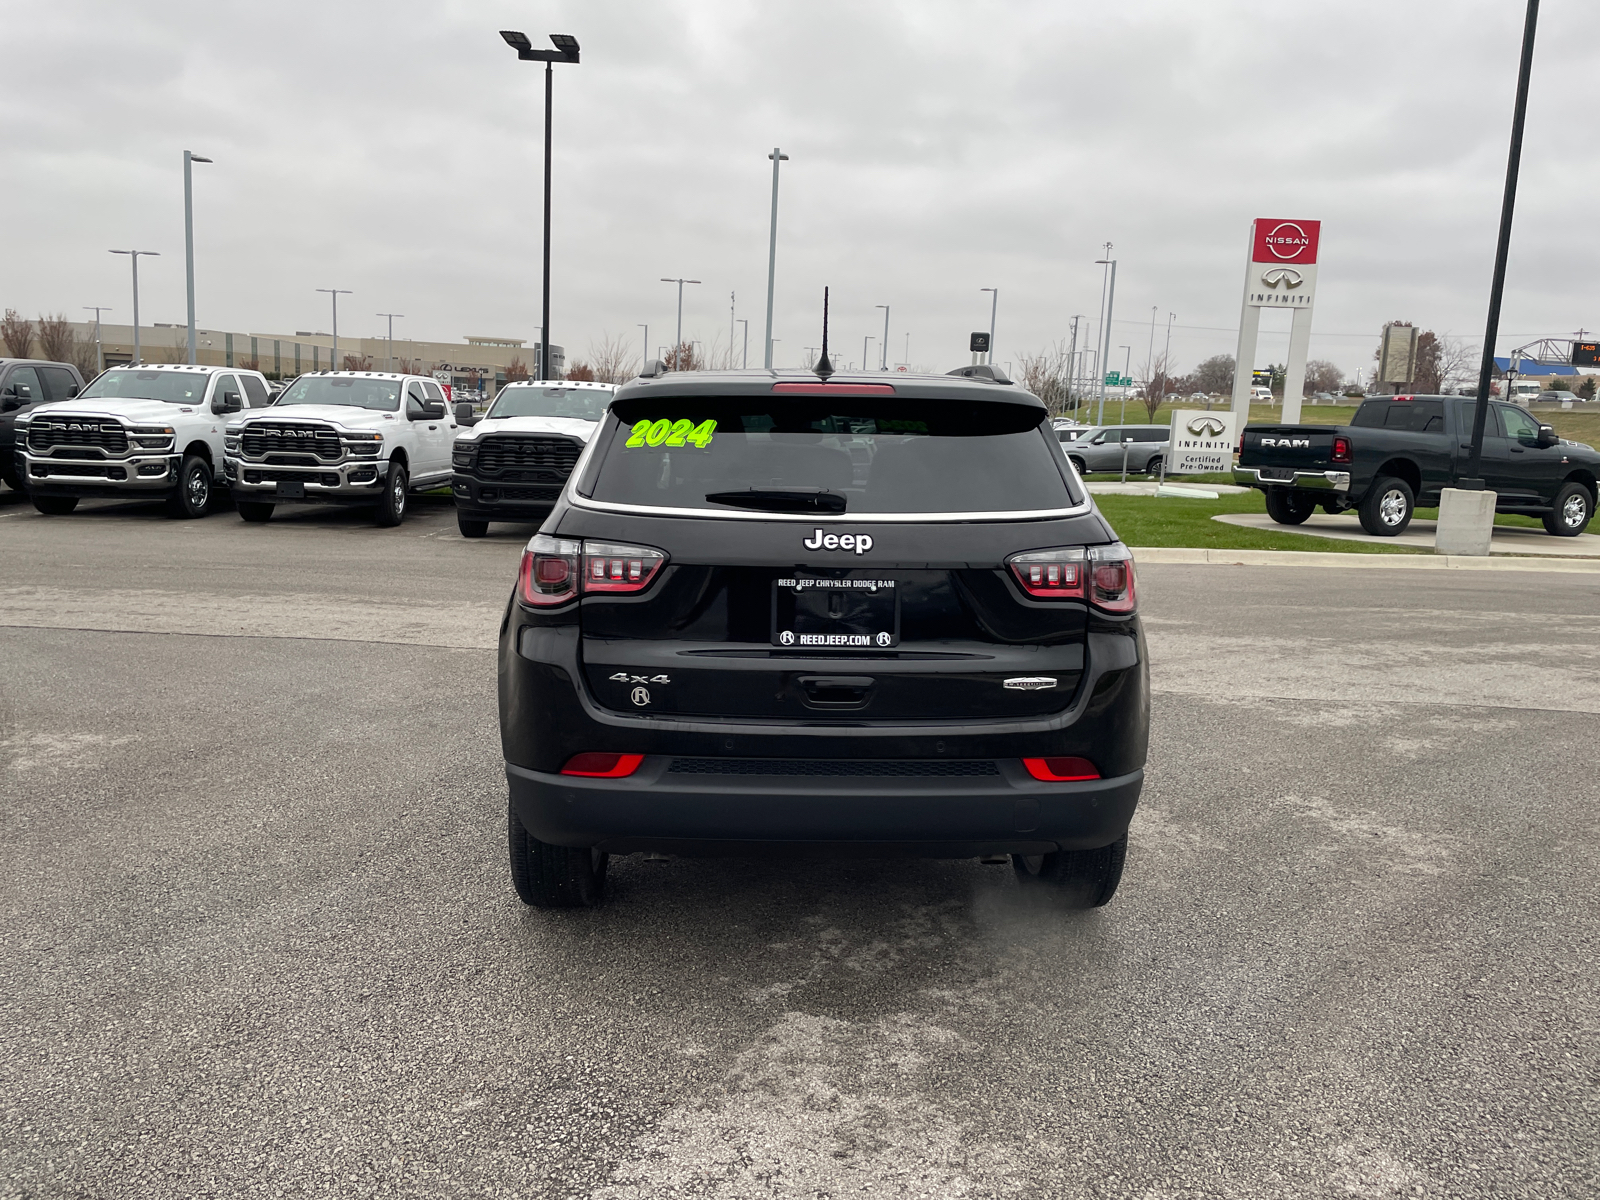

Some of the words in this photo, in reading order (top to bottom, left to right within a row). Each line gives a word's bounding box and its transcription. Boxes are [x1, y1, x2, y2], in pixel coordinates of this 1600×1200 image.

[1265, 236, 1309, 245] NISSAN
[1250, 293, 1311, 304] INFINITI
[454, 366, 489, 374] LEXUS
[50, 422, 99, 432] RAM
[265, 428, 314, 438] RAM
[625, 418, 718, 449] 2024
[503, 443, 555, 453] RAM
[1178, 440, 1230, 449] INFINITI
[1260, 438, 1310, 449] RAM
[1185, 455, 1221, 463] Certified
[1180, 463, 1224, 471] Pre-Owned
[803, 528, 875, 556] Jeep
[778, 579, 796, 587] REED
[798, 579, 815, 588] JEEP
[816, 579, 851, 588] CHRYSLER
[853, 580, 876, 588] DODGE
[878, 580, 895, 588] RAM
[800, 634, 870, 645] REEDJEEP.COM
[608, 672, 671, 685] 4x4
